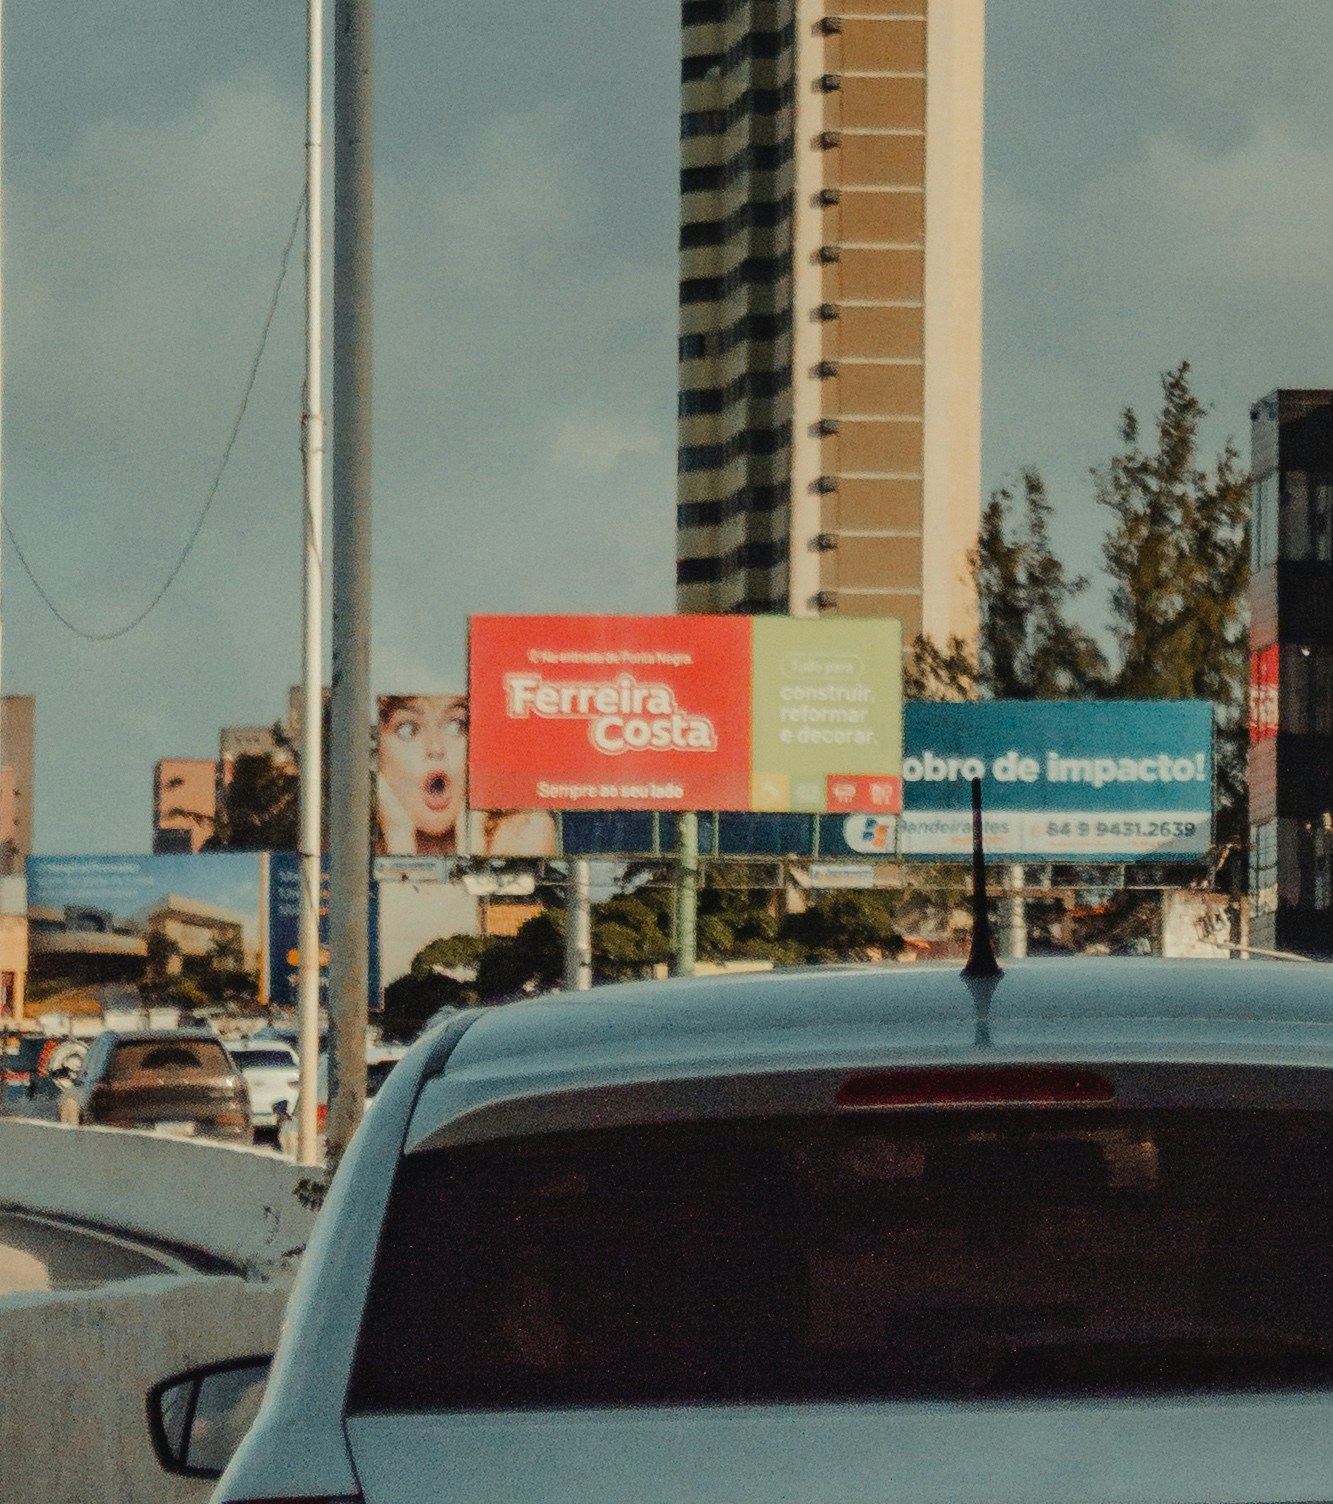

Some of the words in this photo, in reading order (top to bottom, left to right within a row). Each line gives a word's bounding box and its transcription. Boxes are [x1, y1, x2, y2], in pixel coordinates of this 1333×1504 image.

[508, 675, 674, 715] Ferreira
[594, 713, 714, 751] Costa
[991, 751, 1041, 783] de
[1047, 751, 1206, 789] impacto!
